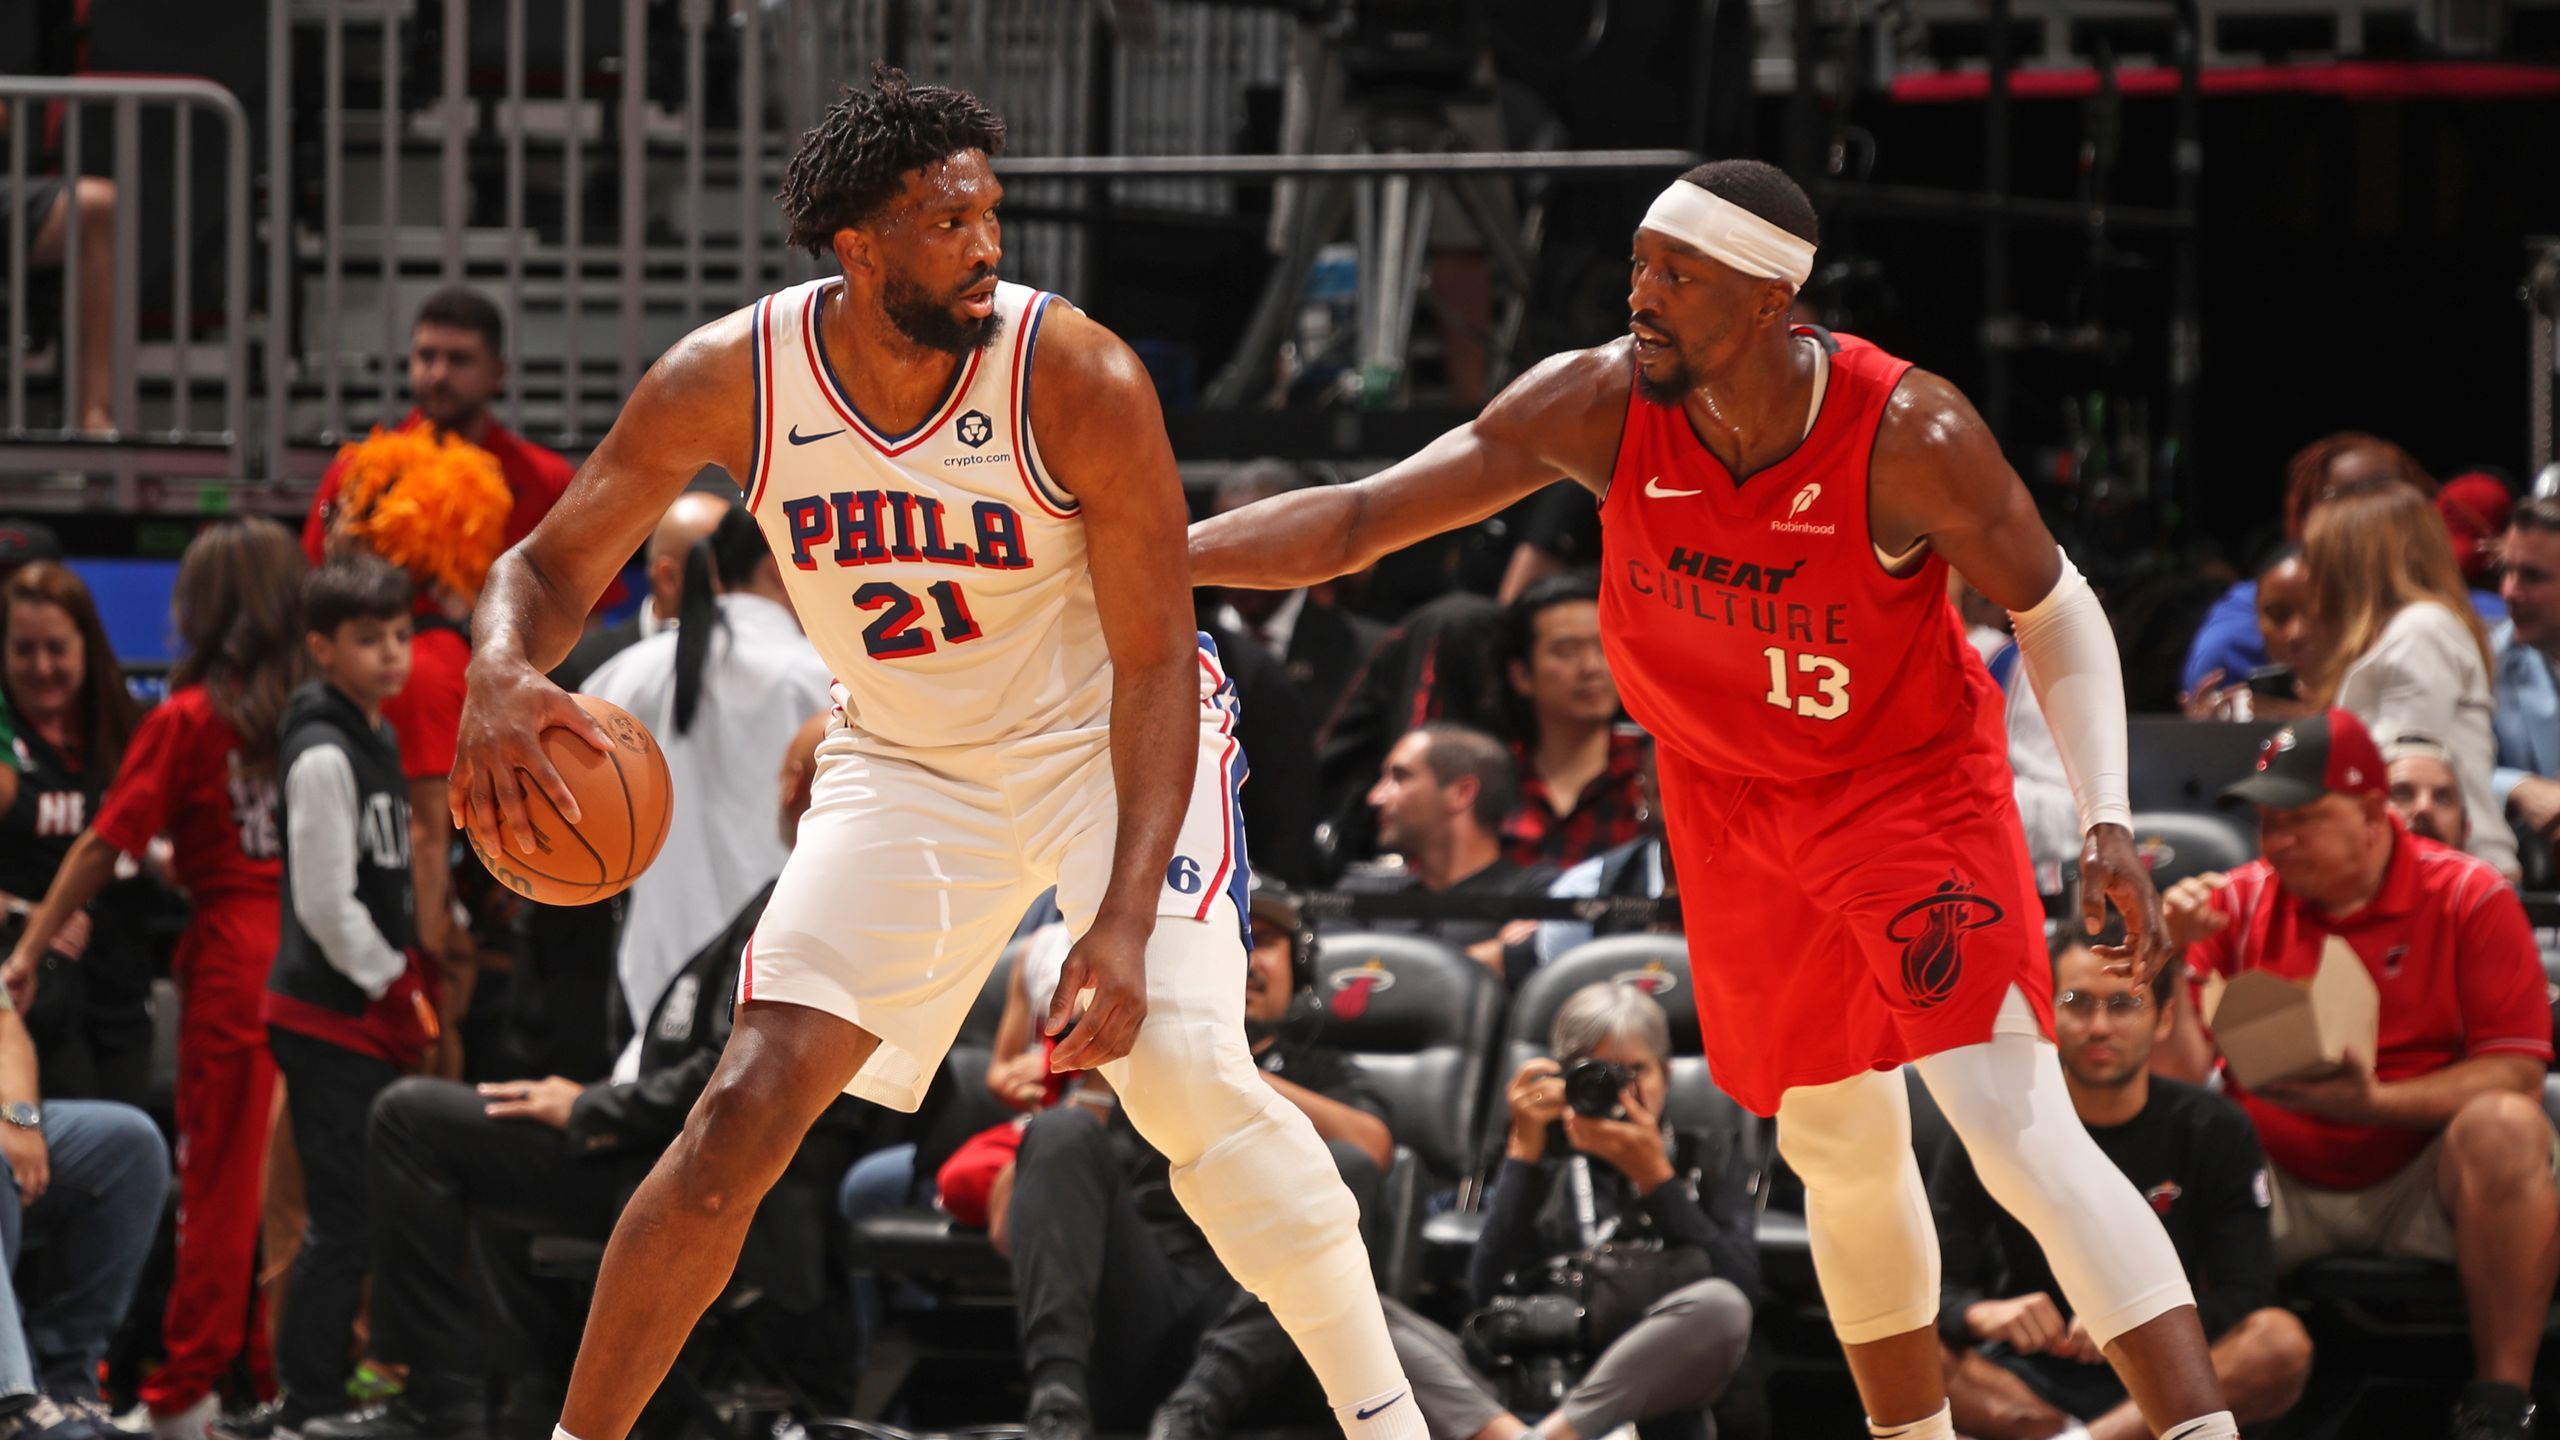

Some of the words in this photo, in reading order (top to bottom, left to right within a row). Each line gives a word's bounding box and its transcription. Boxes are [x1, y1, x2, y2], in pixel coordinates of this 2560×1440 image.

[944, 453, 1010, 467] crypto.com
[783, 490, 1034, 570] PHILA
[1771, 520, 1835, 535] Robinhood
[1627, 559, 1848, 644] CULTURE
[1667, 546, 1807, 594] HEAT
[852, 580, 983, 661] 21
[1763, 646, 1850, 721] 13
